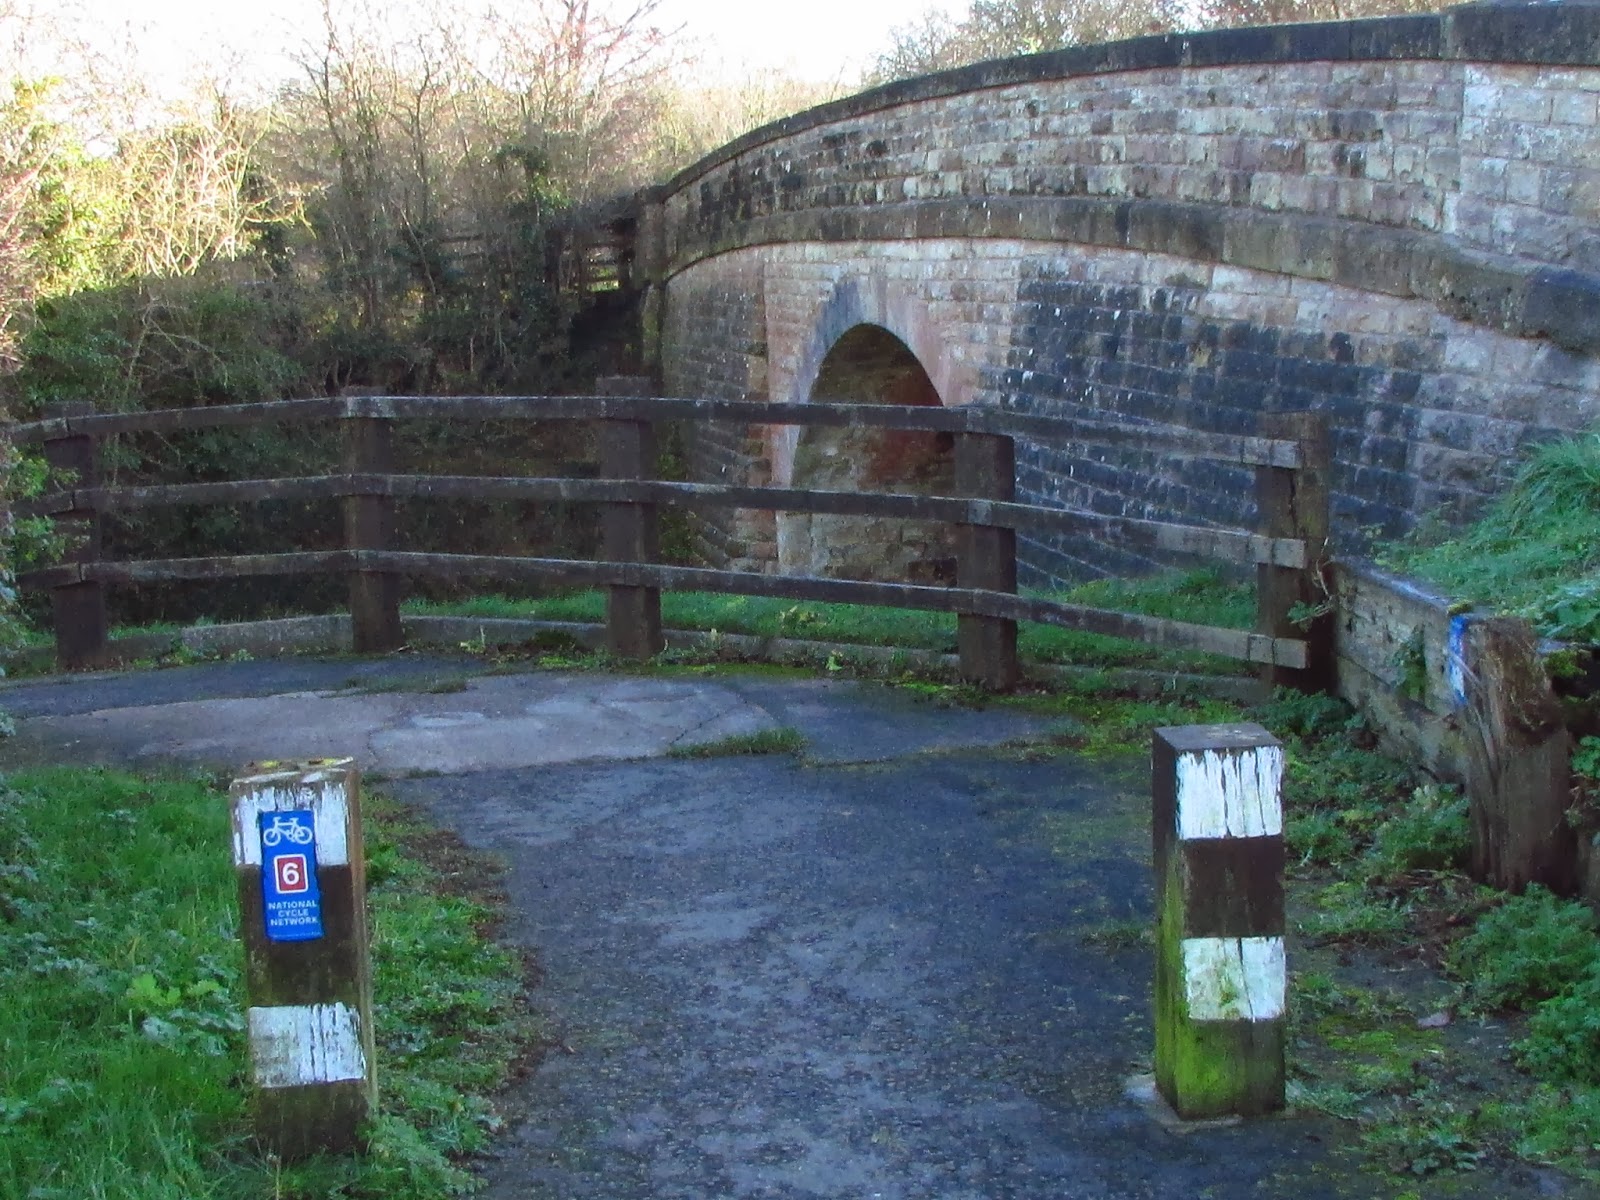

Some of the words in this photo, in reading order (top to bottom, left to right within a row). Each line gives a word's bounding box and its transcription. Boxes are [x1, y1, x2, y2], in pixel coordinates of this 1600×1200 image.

[282, 862, 300, 885] 6
[268, 900, 317, 910] NATIONAL
[278, 908, 309, 917] CYCLE
[270, 917, 318, 926] NETWORK
